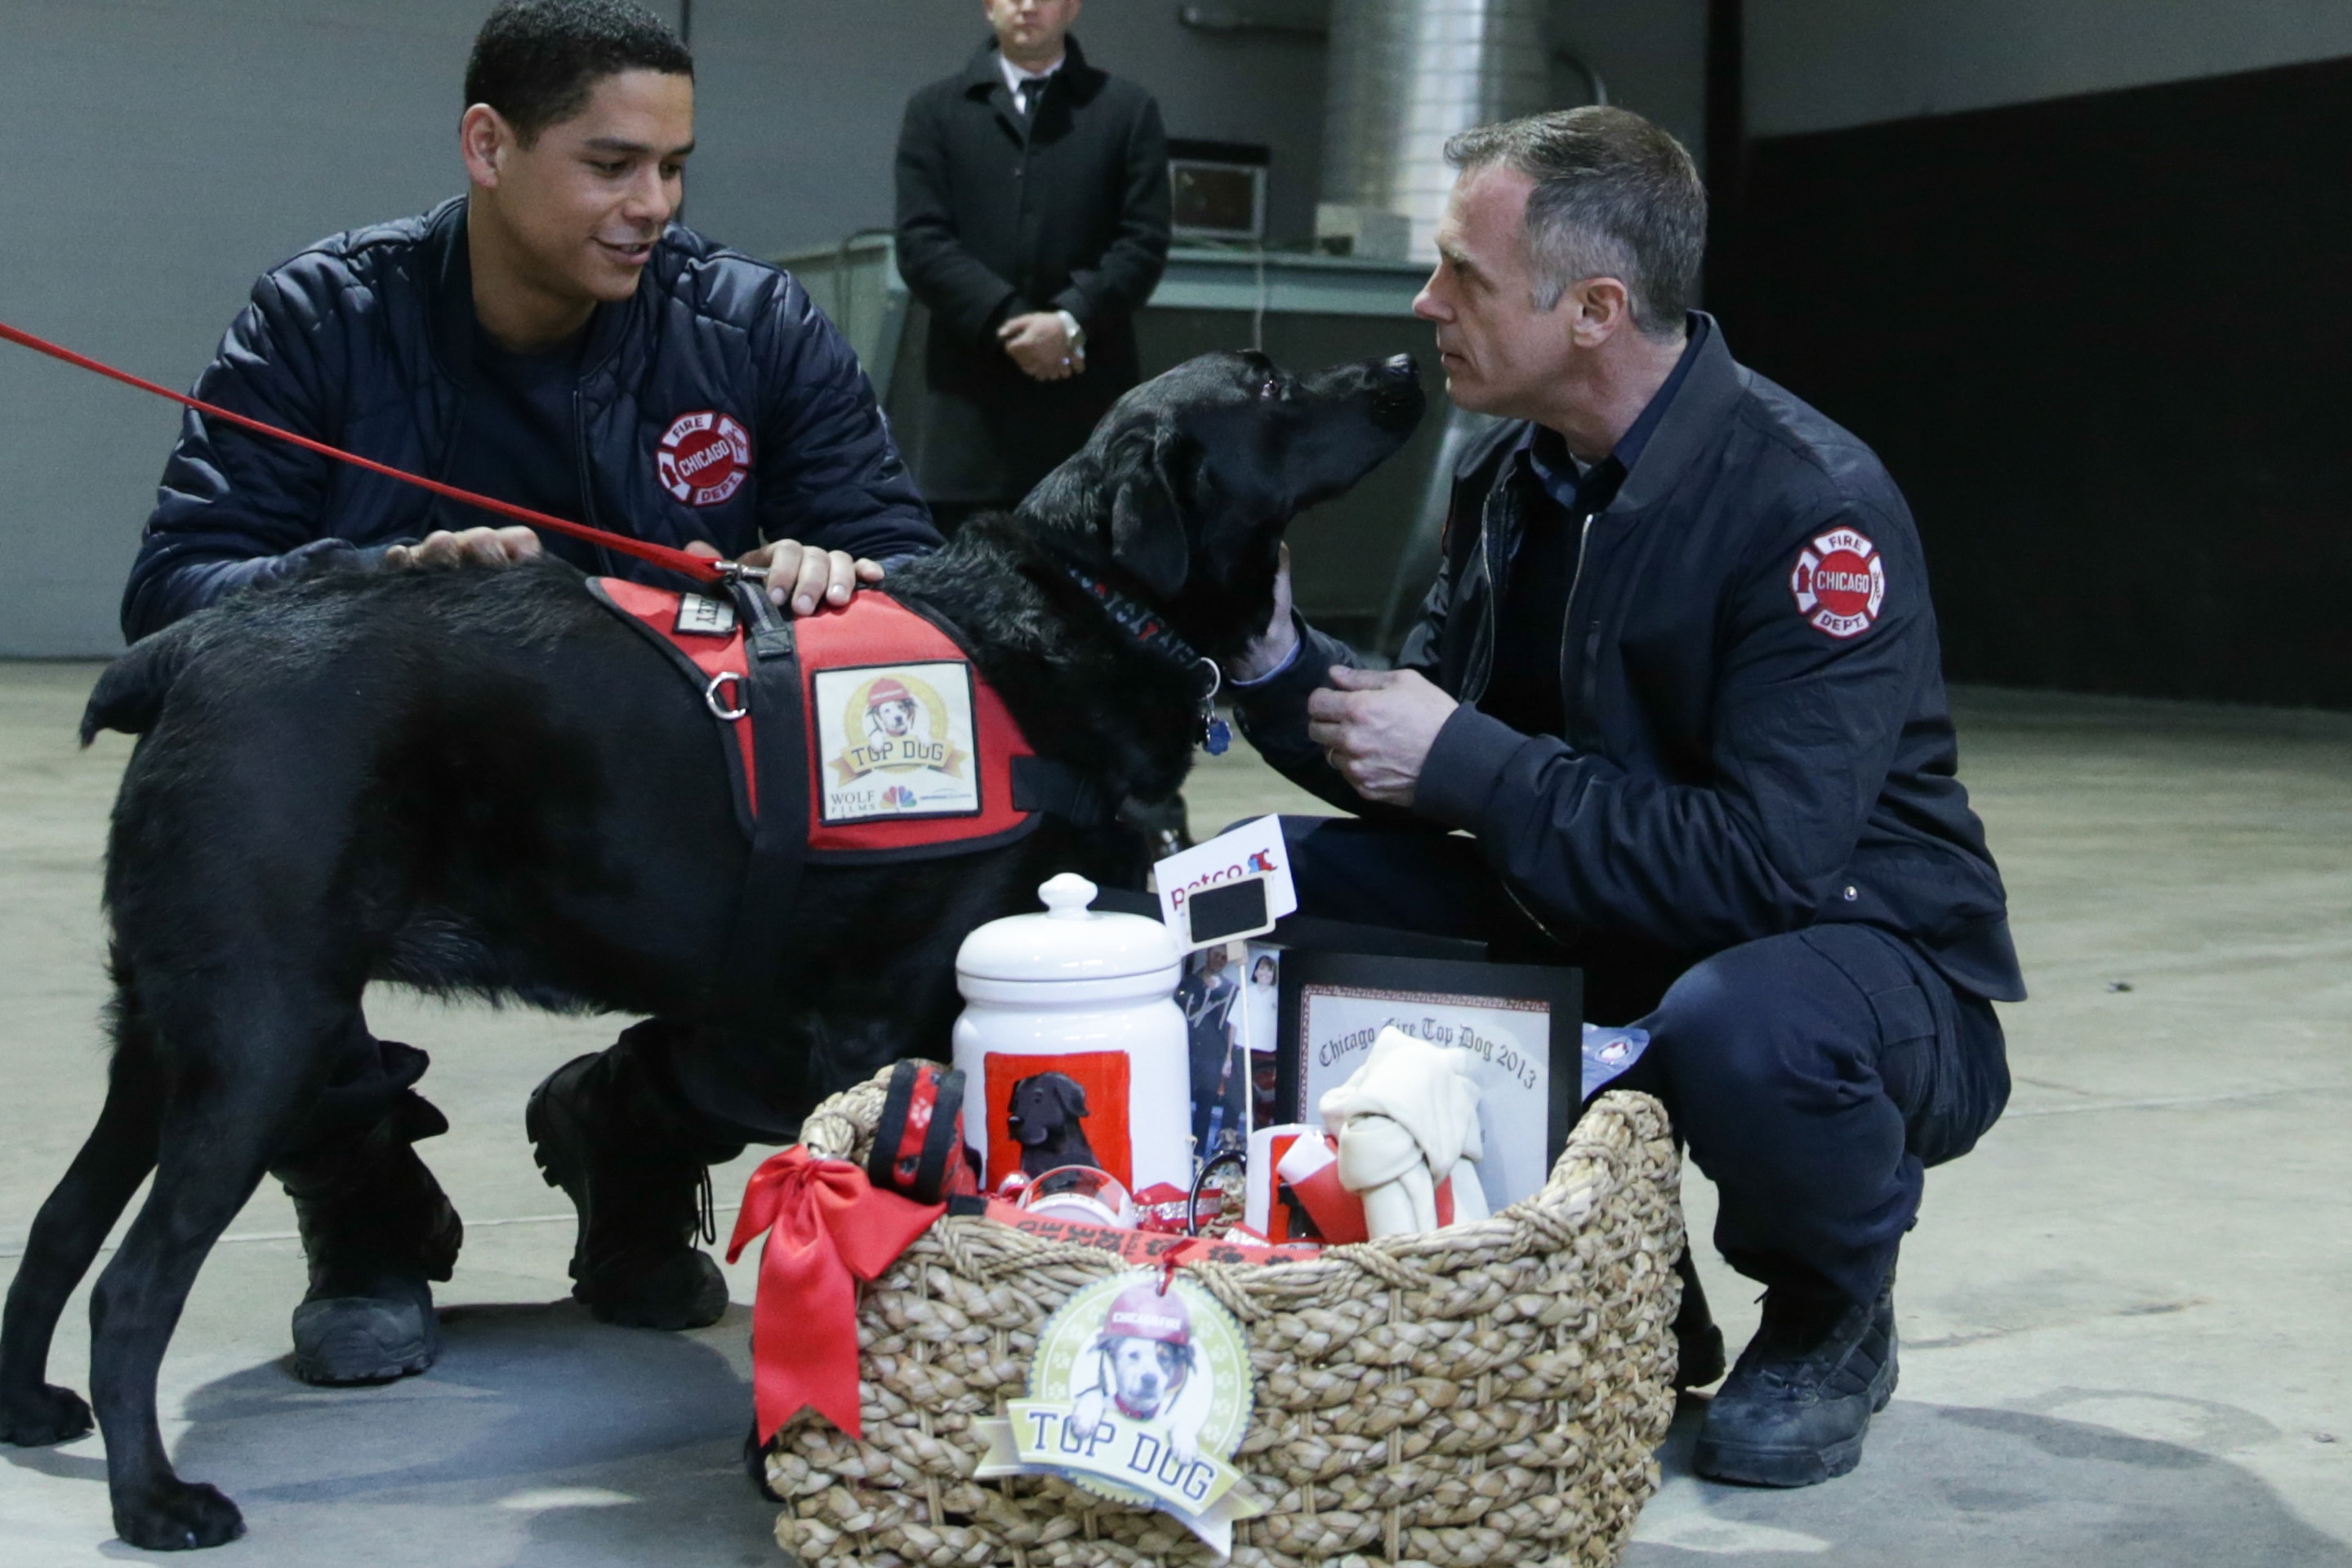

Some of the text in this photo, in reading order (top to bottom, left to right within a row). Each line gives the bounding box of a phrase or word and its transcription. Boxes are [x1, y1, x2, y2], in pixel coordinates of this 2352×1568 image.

[671, 416, 704, 439] FIRE
[679, 439, 730, 477] CHICAGO
[1829, 535, 1863, 550] FIRE
[1816, 571, 1869, 593] CHICAGO
[851, 741, 944, 767] TOP DOG
[831, 791, 875, 806] WOLF
[831, 802, 877, 814] FILMS
[1318, 1027, 1375, 1067] Chicago
[1422, 1018, 1453, 1046] Top
[1458, 1024, 1494, 1062] Dog
[1496, 1045, 1536, 1089] 2013
[1029, 1411, 1215, 1501] TOP DOG
